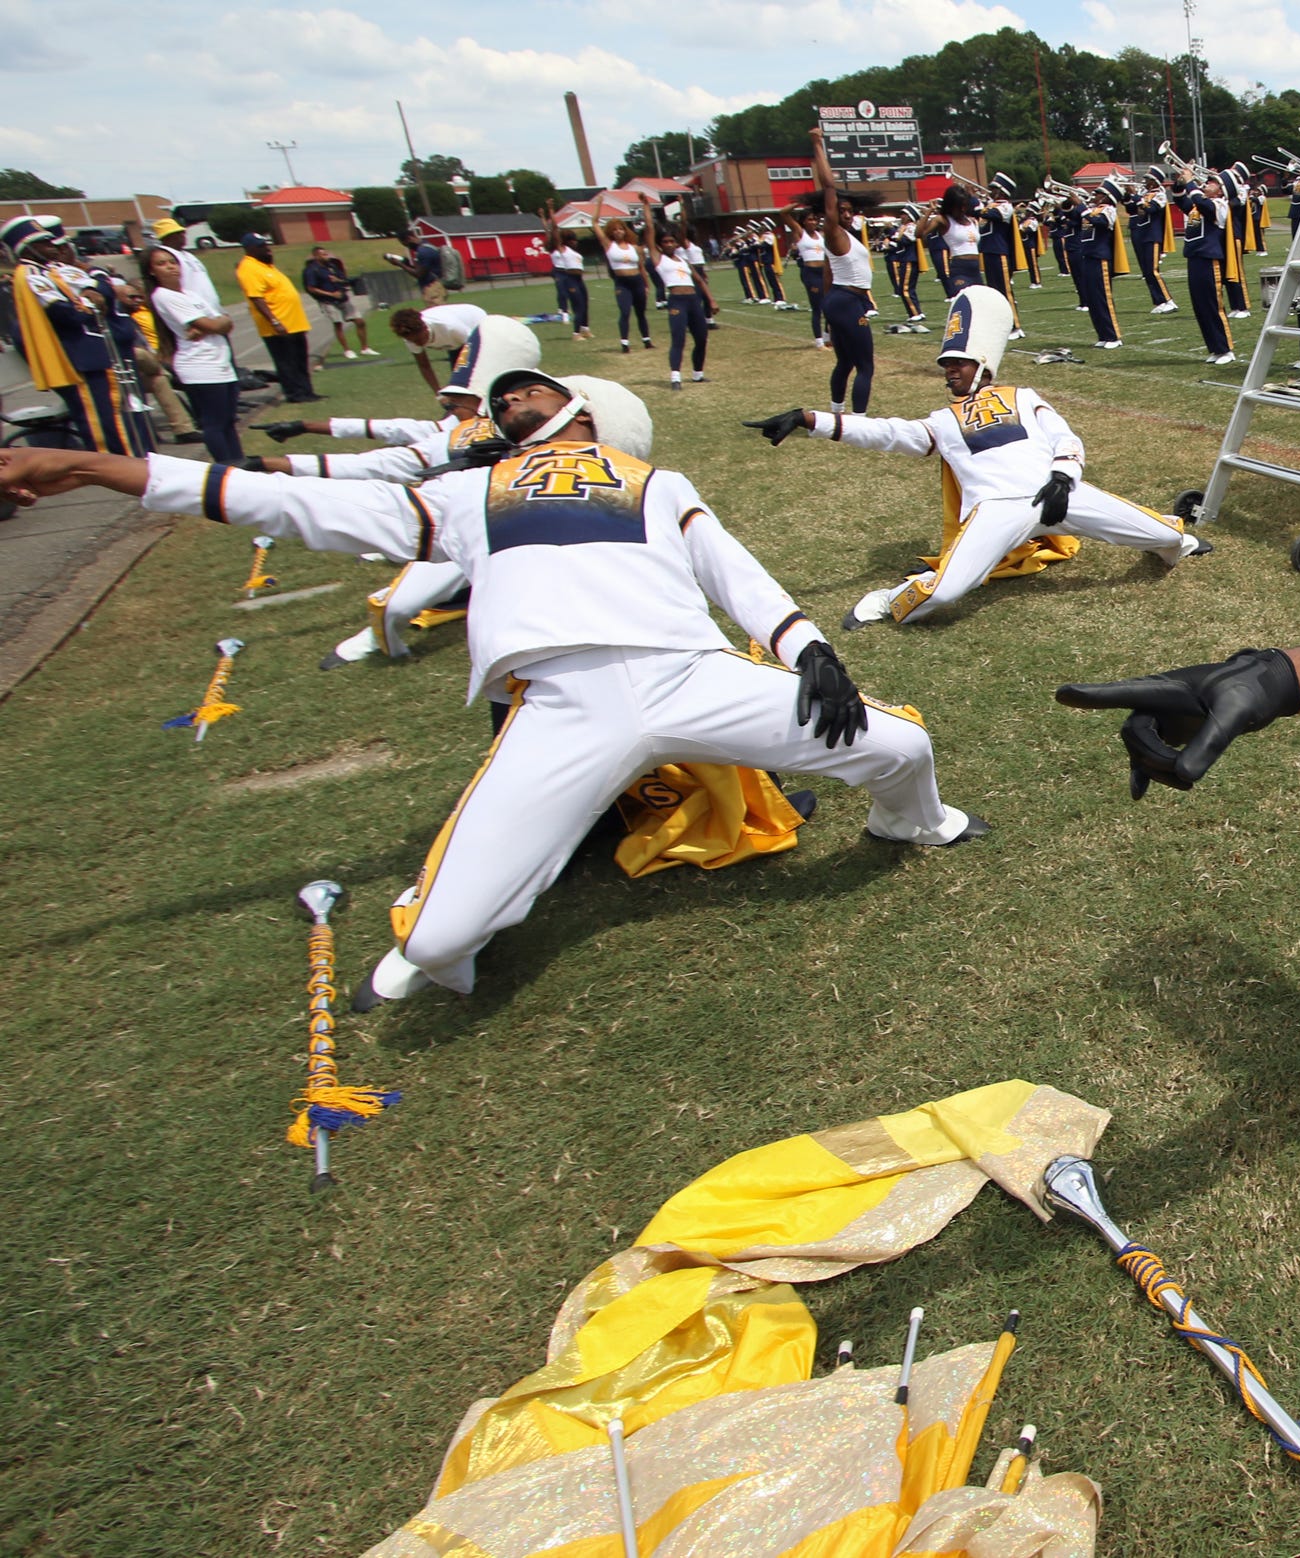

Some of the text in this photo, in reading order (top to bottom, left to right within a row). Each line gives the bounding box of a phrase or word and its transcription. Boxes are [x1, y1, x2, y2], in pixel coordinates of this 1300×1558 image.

[819, 106, 913, 118] SOUTH POINT
[823, 121, 916, 132] Home of the Red Raiders
